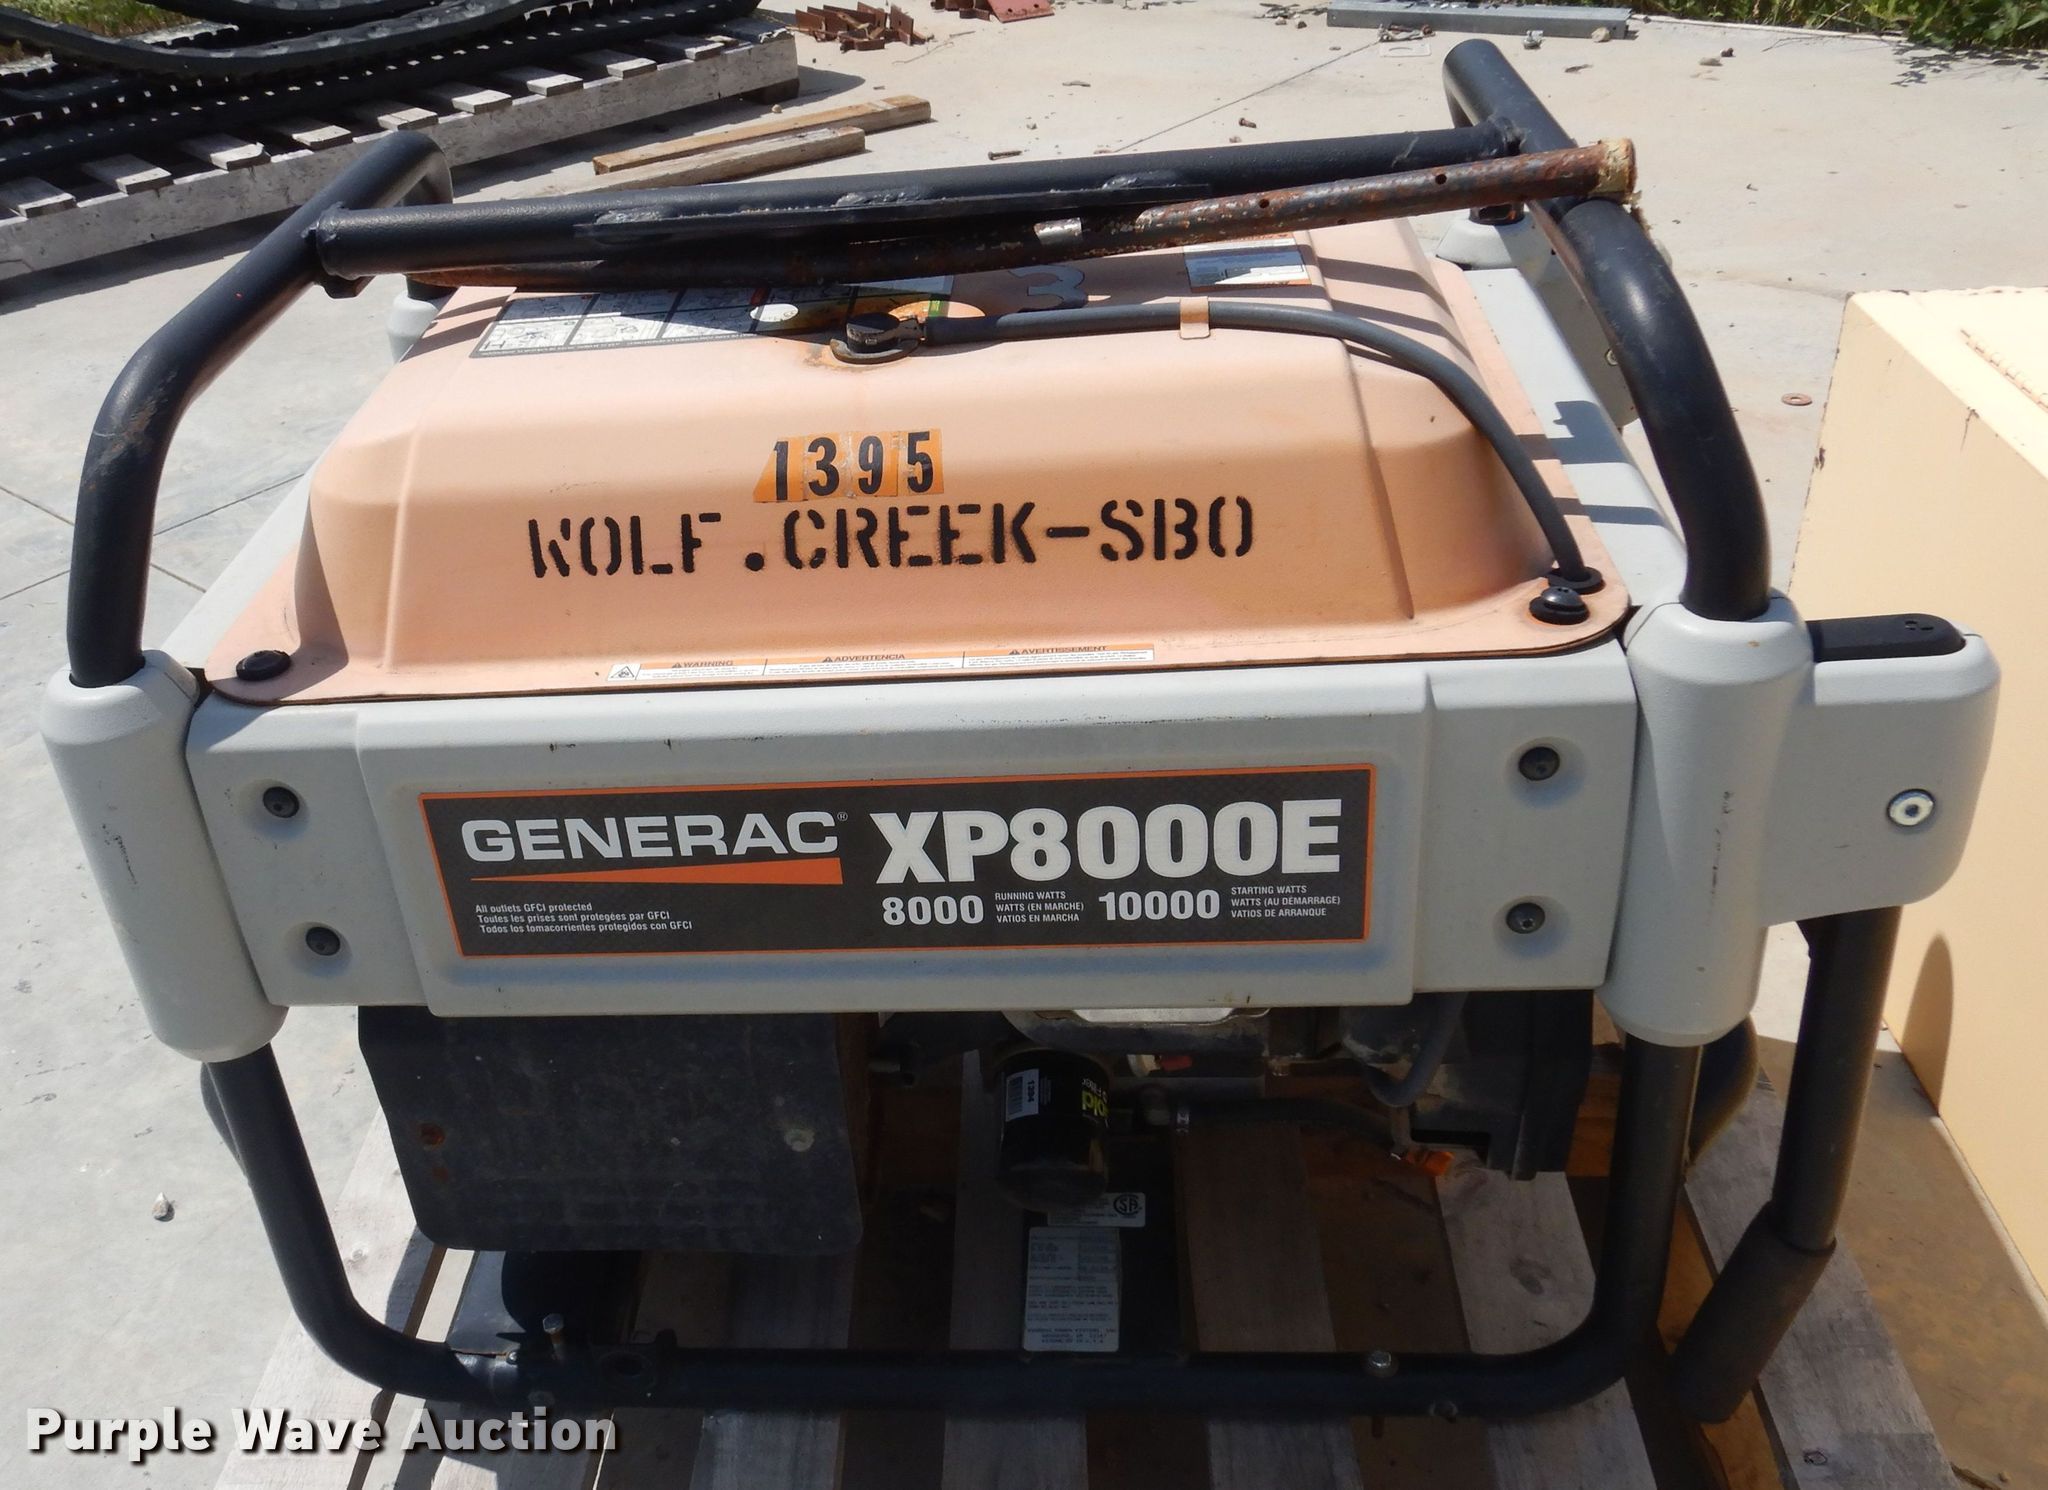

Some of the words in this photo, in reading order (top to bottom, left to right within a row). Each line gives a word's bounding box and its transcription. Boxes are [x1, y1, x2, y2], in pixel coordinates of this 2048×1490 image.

[775, 430, 934, 500] 1395
[1021, 646, 1107, 655] AVERTISSEMENT
[683, 660, 734, 668] WARNING
[834, 654, 905, 662] ADVERTENCIA
[461, 811, 839, 862] GENERAC
[869, 798, 1342, 884] XP8000E
[995, 892, 1033, 902] RUNNING
[1036, 890, 1066, 900] WATTS
[1231, 886, 1274, 896] STARTING
[1276, 885, 1307, 895] WATTS
[995, 902, 1025, 912] WATTS
[1026, 902, 1042, 912] (EN
[1043, 901, 1085, 912] MARCHE)
[1098, 889, 1220, 922] 10000
[1231, 897, 1262, 907] WATTS
[1264, 896, 1278, 906] (AU
[475, 904, 488, 914] All
[490, 904, 522, 913] outlets
[524, 903, 546, 912] GFCI
[548, 902, 593, 914] protected
[882, 894, 984, 926] 8000
[1231, 908, 1263, 918] VATIOS
[1264, 908, 1276, 917] DE
[1278, 907, 1327, 917] ARRANQUE
[478, 914, 509, 924] Toutes
[511, 914, 525, 924] les
[528, 914, 556, 925] prises
[558, 914, 578, 923] sont
[629, 912, 645, 922] par
[647, 911, 670, 920] GFCI
[996, 914, 1028, 924] VATIOS
[1029, 914, 1041, 923] EN
[1042, 913, 1080, 923] MARCHA
[480, 924, 508, 934] Todos
[510, 924, 524, 933] los
[527, 922, 596, 933] tomacorrientes
[598, 922, 648, 934] protegidos
[650, 922, 667, 931] con
[669, 921, 693, 931] GFCI
